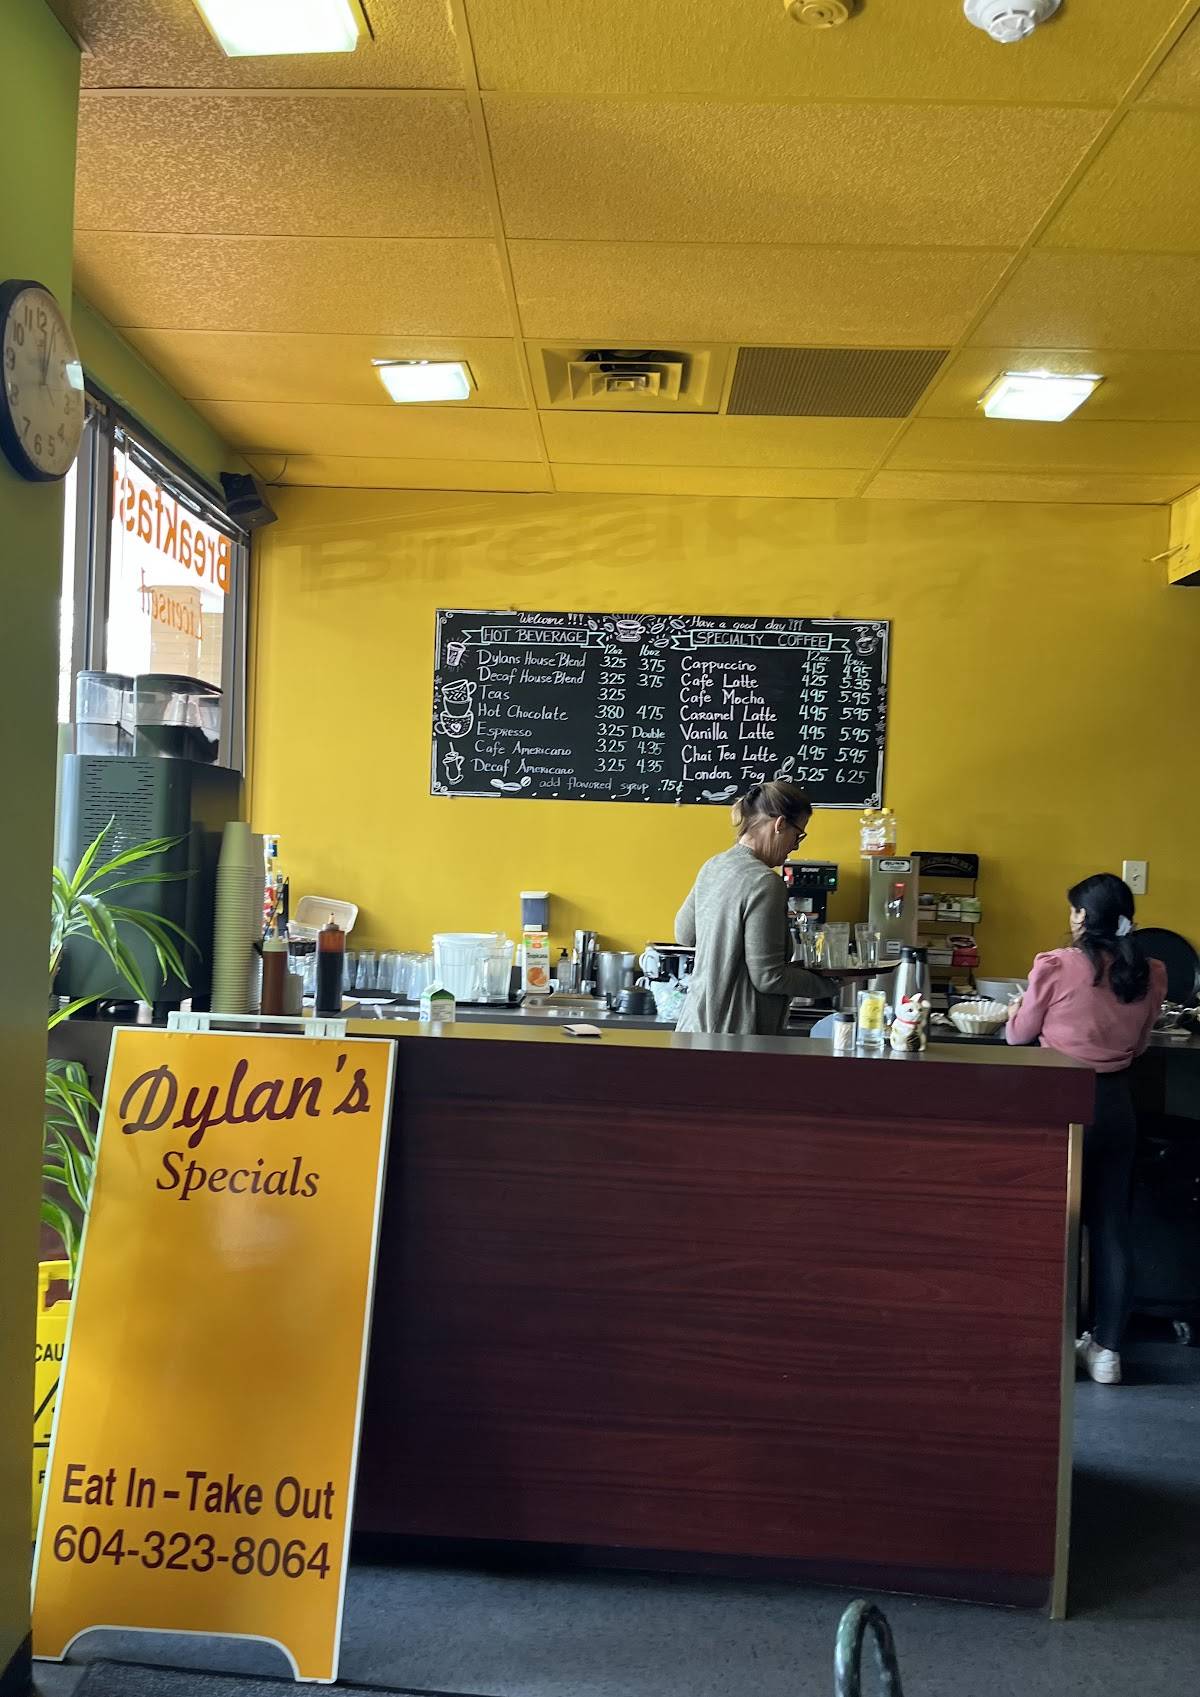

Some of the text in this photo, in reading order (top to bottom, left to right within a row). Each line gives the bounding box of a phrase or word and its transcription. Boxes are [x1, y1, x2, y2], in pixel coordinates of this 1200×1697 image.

[519, 613, 563, 625] Welcome
[690, 616, 714, 627] Have
[733, 619, 756, 631] good
[765, 619, 785, 631] day
[484, 629, 584, 643] HOT BEVERAGE
[694, 633, 826, 647] SPECIALTY COFFEE
[477, 650, 521, 666] Dylans
[525, 652, 556, 667] House
[556, 652, 586, 668] Blend
[681, 657, 756, 673] Cappuccino
[478, 667, 517, 684] Decaf
[521, 669, 552, 683] House
[552, 670, 584, 684] Blend
[681, 672, 714, 689] Cafe
[723, 673, 758, 688] Latte
[479, 685, 509, 700] Teas
[680, 688, 712, 707] Cafe
[723, 689, 764, 705] Mocha
[478, 703, 501, 717] Hot
[507, 706, 568, 720] Chocolate
[680, 707, 734, 721] Caramel
[743, 707, 777, 721] Latte
[477, 722, 532, 739] Espresso
[632, 726, 665, 739] Double
[680, 723, 728, 741] Vanilla
[739, 724, 774, 740] Latte
[475, 741, 505, 755] Cafe
[511, 742, 572, 755] Americano
[681, 745, 711, 763] Chai
[717, 745, 735, 759] Tea
[743, 746, 778, 762] Latte
[470, 758, 510, 777] Decaf
[517, 759, 575, 775] Americano
[683, 765, 732, 780] London
[740, 766, 765, 783] Fog
[539, 778, 560, 787] add
[567, 777, 611, 790] flavored
[620, 782, 649, 797] syrup
[119, 1054, 371, 1149] Dylan's
[156, 1151, 320, 1200] Specials
[63, 1464, 117, 1506] Eat
[276, 1476, 335, 1521] Out
[54, 1524, 331, 1580] 604-323-8064
